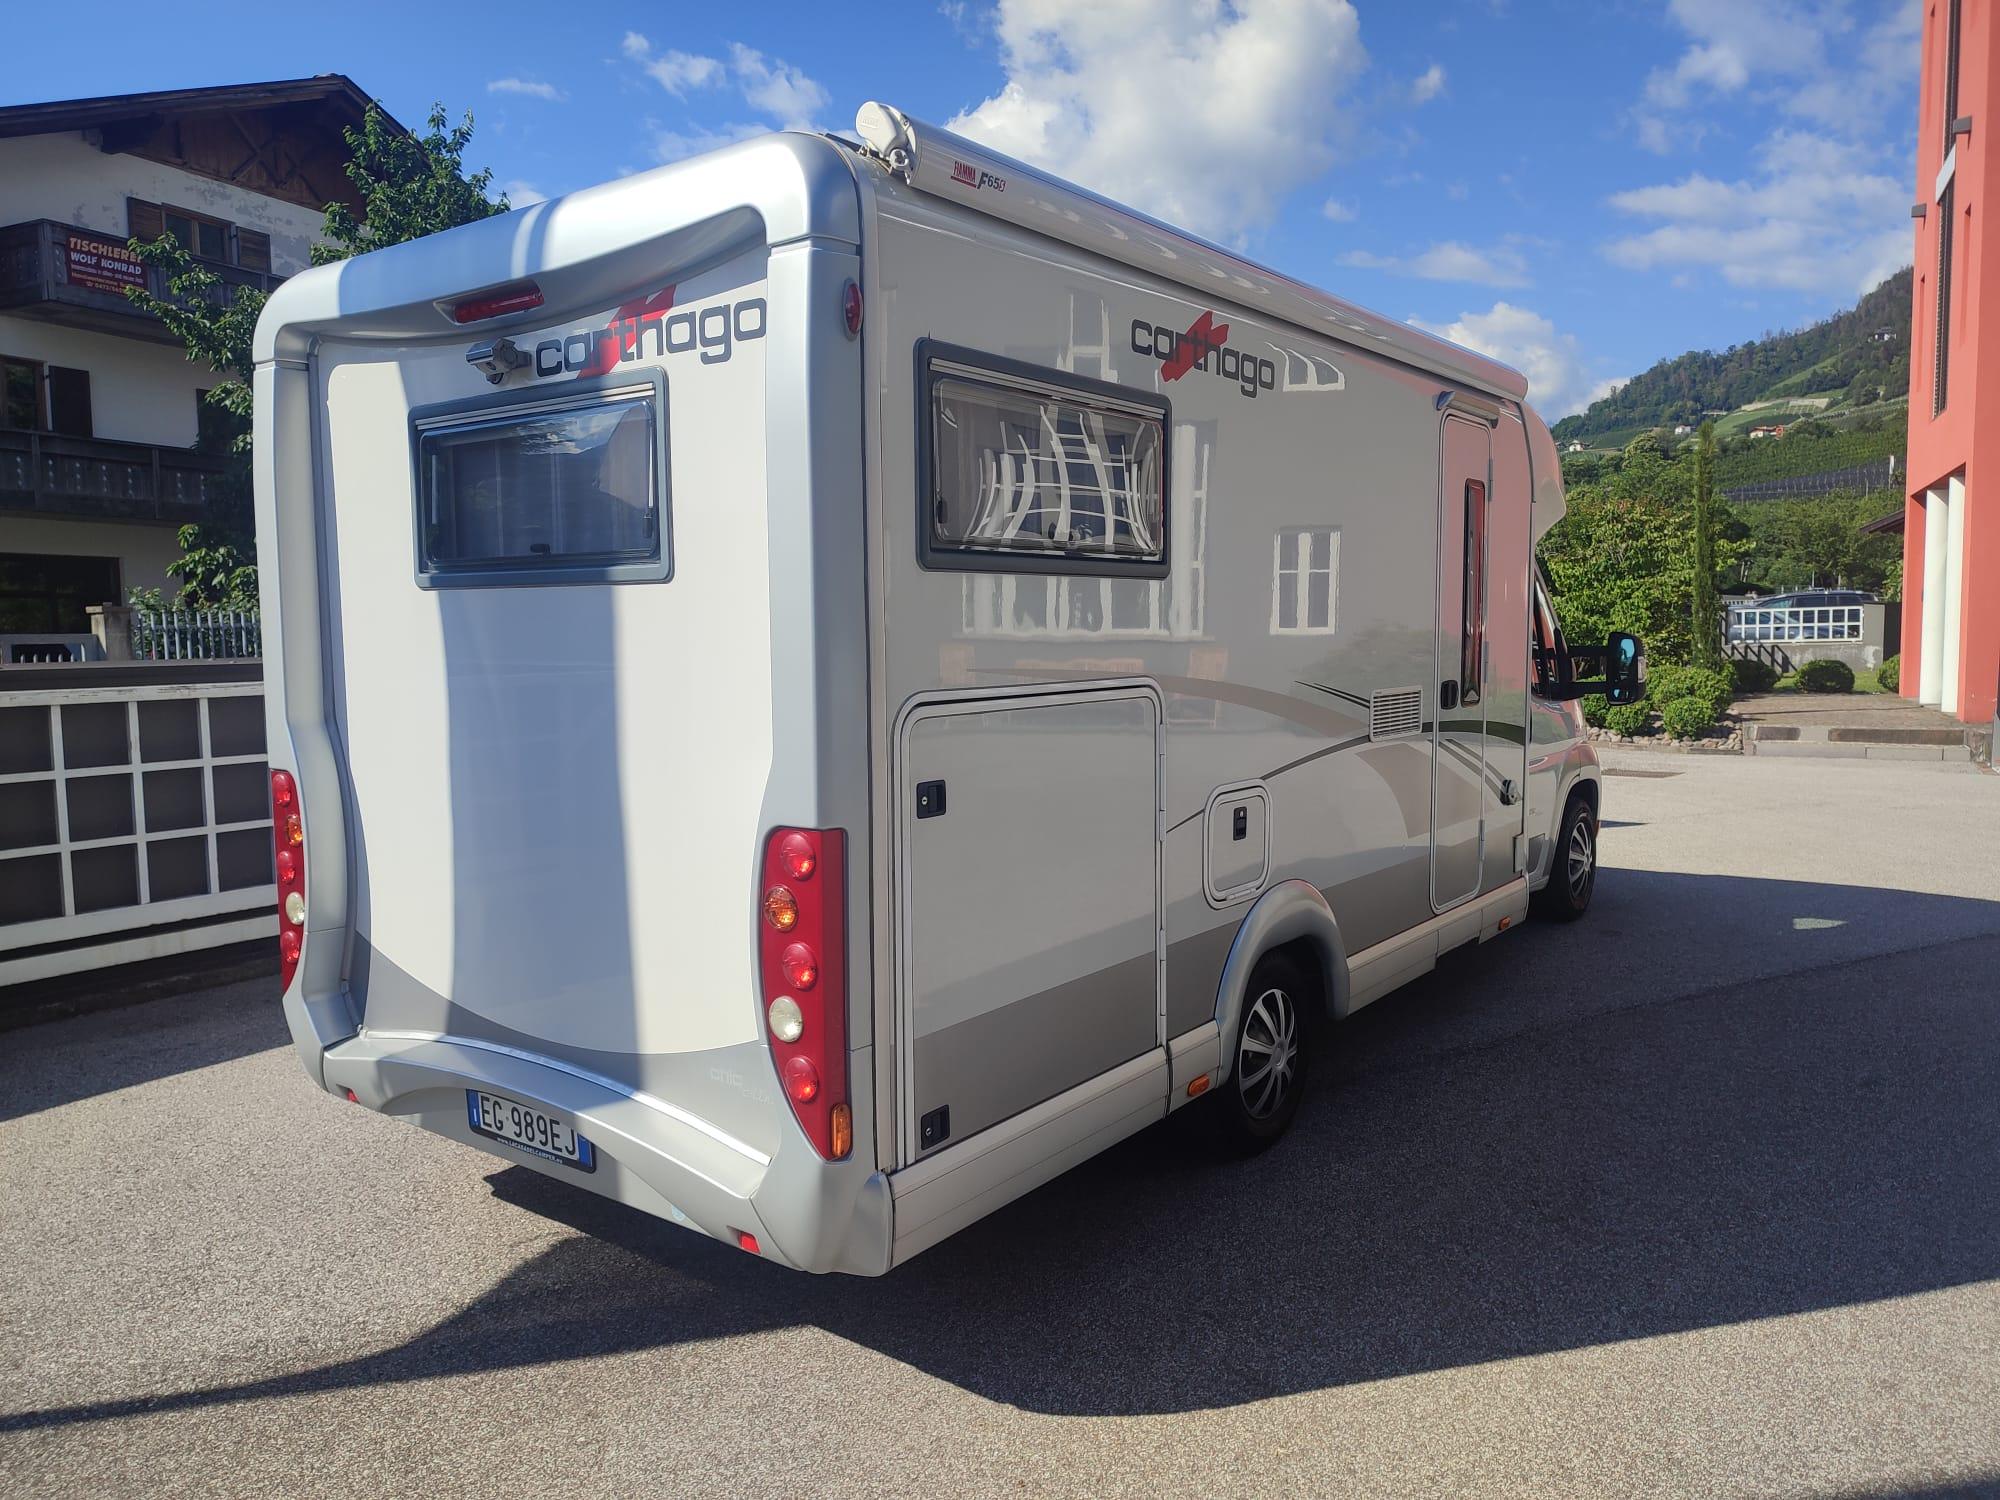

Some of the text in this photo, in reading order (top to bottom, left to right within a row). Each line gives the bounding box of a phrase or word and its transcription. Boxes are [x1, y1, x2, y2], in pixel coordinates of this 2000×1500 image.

[953, 160, 976, 183] FIAMMA
[70, 251, 98, 265] WOLF
[101, 258, 142, 275] KONRAD
[535, 297, 768, 378] carthago
[1131, 318, 1275, 399] carthago
